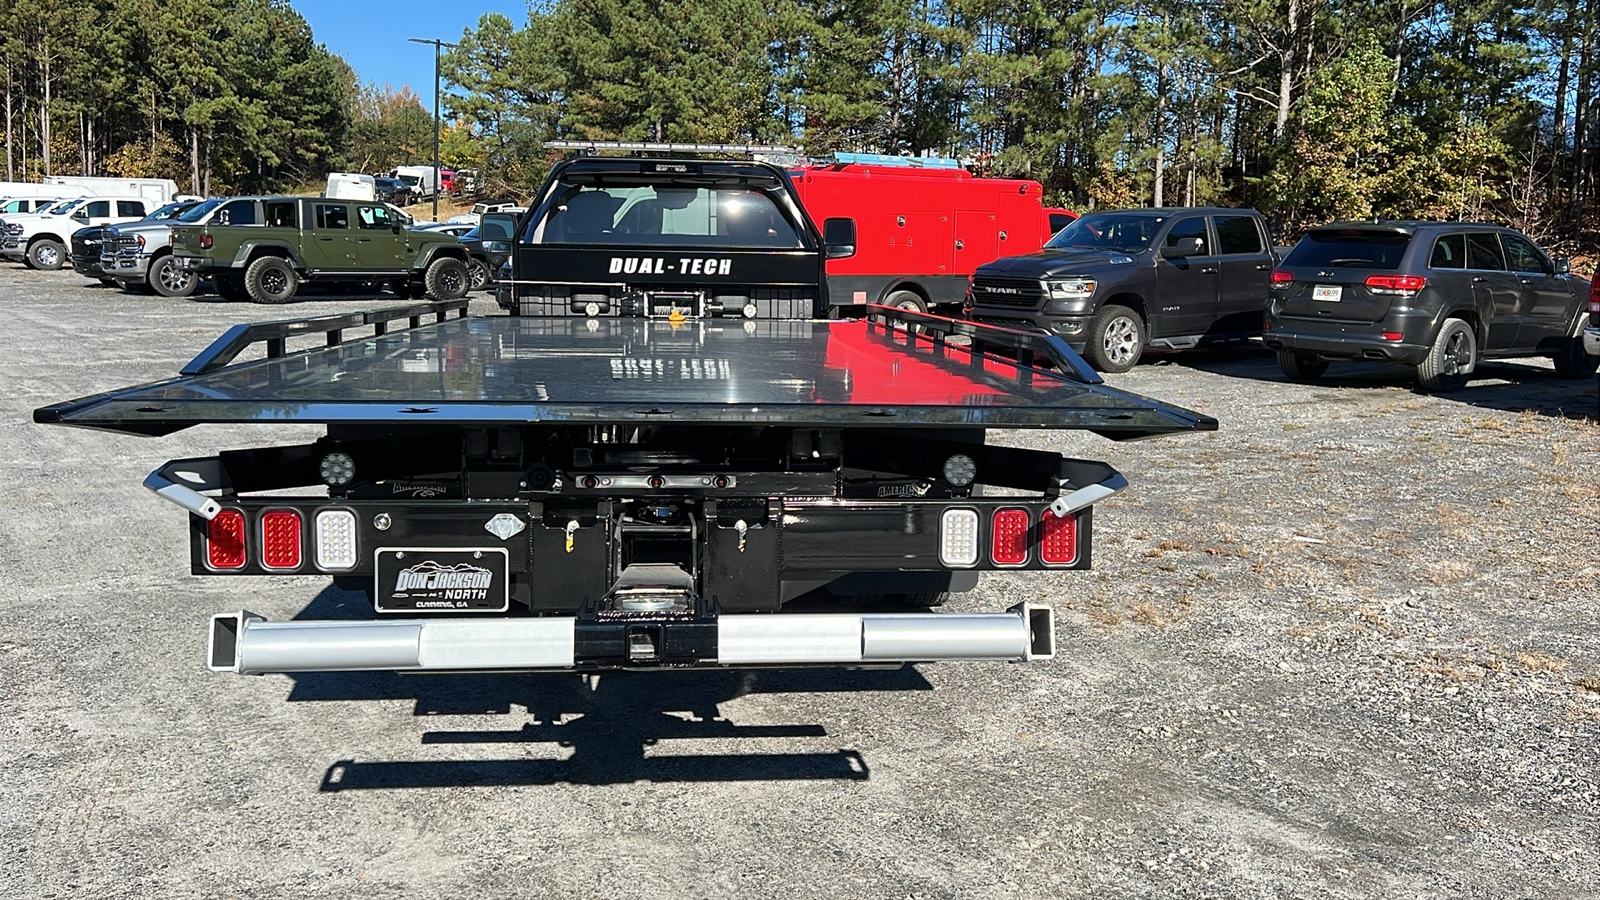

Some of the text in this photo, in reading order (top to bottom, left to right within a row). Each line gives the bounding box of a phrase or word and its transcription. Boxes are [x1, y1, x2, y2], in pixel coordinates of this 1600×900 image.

[985, 286, 1022, 294] RAM
[877, 484, 926, 497] AMERIC
[395, 571, 493, 591] DON JACKSON
[445, 589, 487, 600] NORTH
